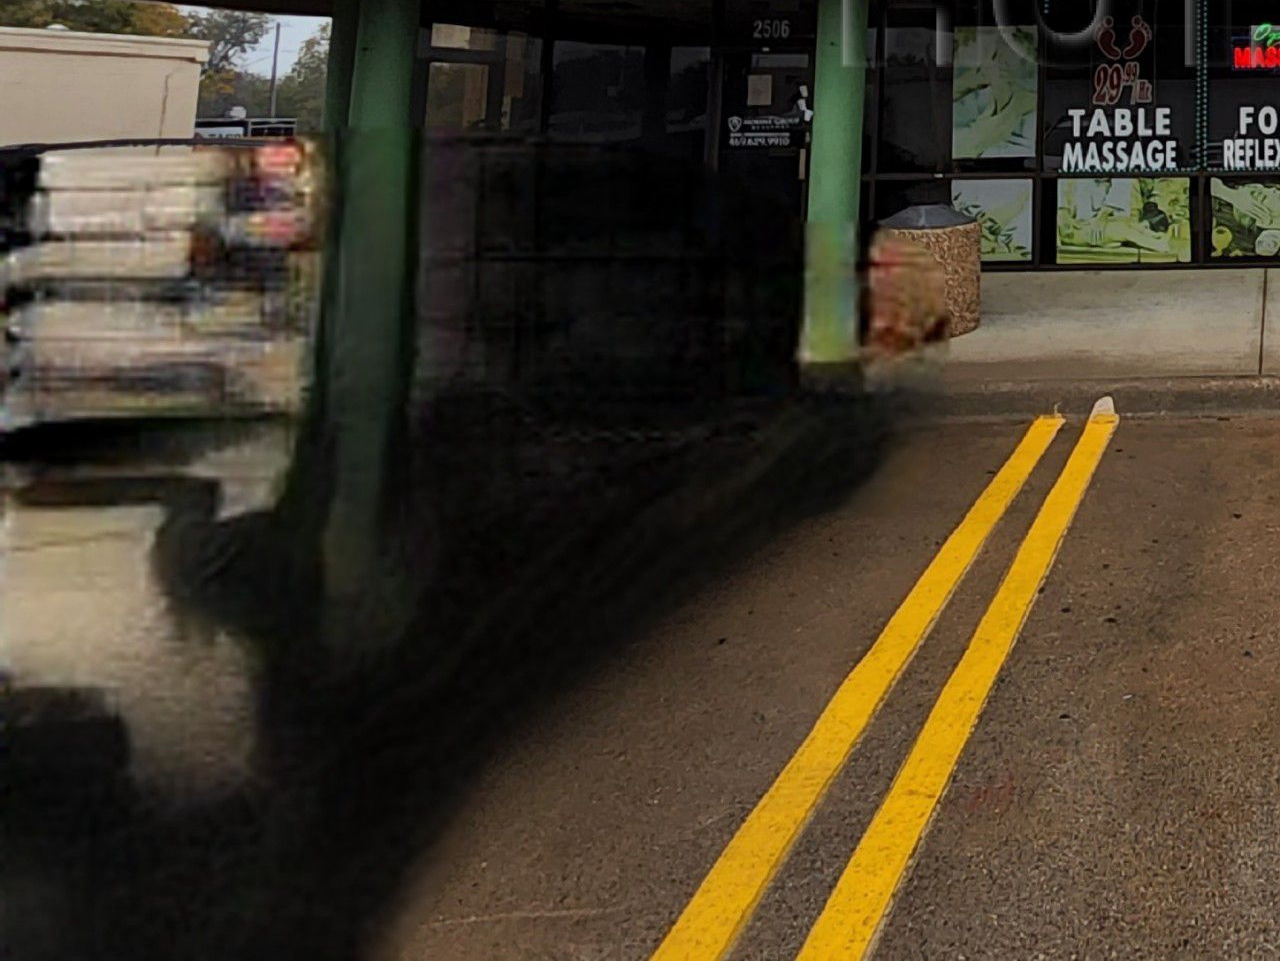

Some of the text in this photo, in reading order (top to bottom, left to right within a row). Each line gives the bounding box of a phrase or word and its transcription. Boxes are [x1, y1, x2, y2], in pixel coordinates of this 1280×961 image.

[753, 20, 790, 38] 2506
[1068, 107, 1171, 137] TABLE
[1062, 140, 1177, 173] MASSAGE
